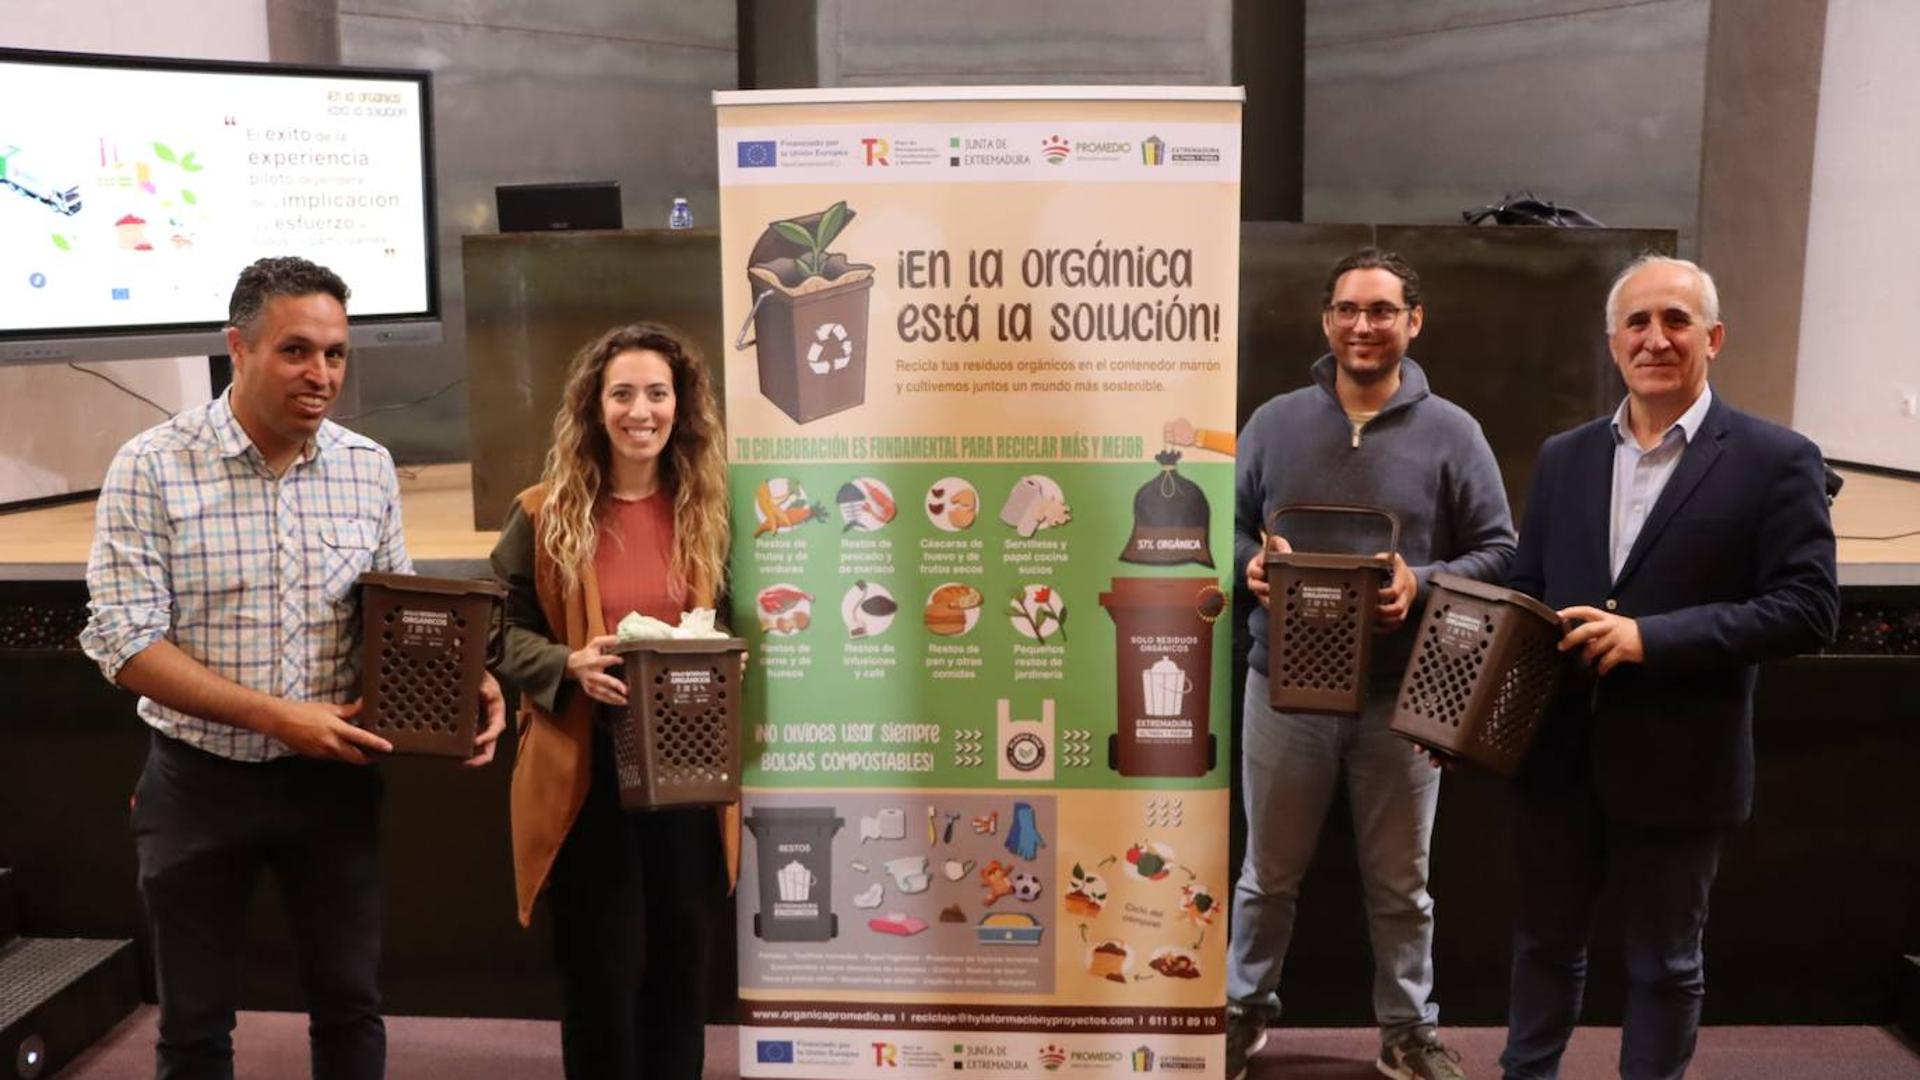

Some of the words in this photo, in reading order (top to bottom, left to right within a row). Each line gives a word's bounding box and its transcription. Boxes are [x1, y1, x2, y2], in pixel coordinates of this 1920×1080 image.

[965, 139, 994, 149] JUNTA
[996, 139, 1007, 149] DE
[1076, 143, 1132, 153] PROMEDIO
[248, 149, 370, 168] experiencia
[964, 156, 1030, 166] EXTREMADURA
[969, 249, 1003, 288] la
[897, 295, 979, 342] está
[998, 302, 1032, 342] la
[1050, 294, 1220, 342] solución!
[896, 359, 939, 372] Recicla
[942, 361, 960, 372] tus
[963, 360, 1013, 372] residuos
[1017, 358, 1075, 374] orgánicos
[1079, 362, 1093, 372] en
[1096, 360, 1107, 372] el
[1110, 359, 1176, 372] contenedor
[1179, 359, 1221, 372] marrón
[896, 383, 903, 394] y
[906, 381, 969, 392] cultivemos
[972, 381, 1009, 395] juntos
[1013, 383, 1027, 392] un
[1031, 381, 1071, 392] mundo
[1075, 381, 1099, 392] más
[1102, 380, 1165, 392] sostenible.
[736, 437, 749, 459] TU
[752, 433, 849, 459] COLABORACIÓN
[852, 437, 867, 458] ES
[870, 436, 958, 458] FUNDAMENTAL
[961, 436, 993, 458] PARA
[997, 436, 1058, 458] RECICLAR
[1061, 431, 1088, 458] MÁS
[1089, 436, 1099, 458] Y
[1102, 436, 1143, 458] MEJOR
[756, 538, 791, 548] Restos
[794, 538, 807, 548] de
[840, 538, 876, 548] Restos
[879, 538, 892, 548] de
[920, 538, 967, 548] Cáscaras
[970, 538, 983, 548] de
[1004, 538, 1058, 549] Servilletas
[1061, 541, 1067, 550] y
[1157, 537, 1200, 550] ORGÁNICA
[755, 551, 784, 560] frutas
[787, 554, 793, 562] y
[795, 551, 808, 560] de
[840, 552, 884, 563] pescado
[923, 552, 955, 561] huevo
[957, 554, 964, 563] y
[966, 552, 980, 561] de
[1003, 552, 1031, 563] papel
[1034, 552, 1068, 561] cocina
[760, 565, 804, 574] verduras
[838, 564, 851, 574] de
[854, 564, 895, 574] marisco
[920, 564, 950, 574] frutos
[953, 565, 983, 574] secos
[1019, 565, 1053, 575] sucios
[1131, 636, 1153, 644] SOLO
[1156, 636, 1198, 644] RESIDUOS
[844, 643, 879, 653] Restos
[882, 643, 895, 653] de
[928, 643, 964, 653] Restos
[966, 643, 980, 653] de
[1139, 642, 1189, 653] ORGÁNICOS
[1015, 657, 1047, 667] restos
[1050, 657, 1063, 667] de
[1136, 719, 1192, 728] EXTREMADURA
[761, 752, 816, 771] BOLSAS
[821, 751, 934, 771] COMPOSTABLES!
[778, 843, 811, 853] RESTOS
[752, 1009, 896, 1023] www.organicapromedio.es
[911, 1012, 1133, 1028] reciclaje@hylaformacionyproyectos.com
[1171, 1017, 1183, 1026] 51
[1204, 1016, 1217, 1027] 10
[1071, 1051, 1122, 1061] PROMEDIO
[967, 1060, 1029, 1071] EXTREMADURA
